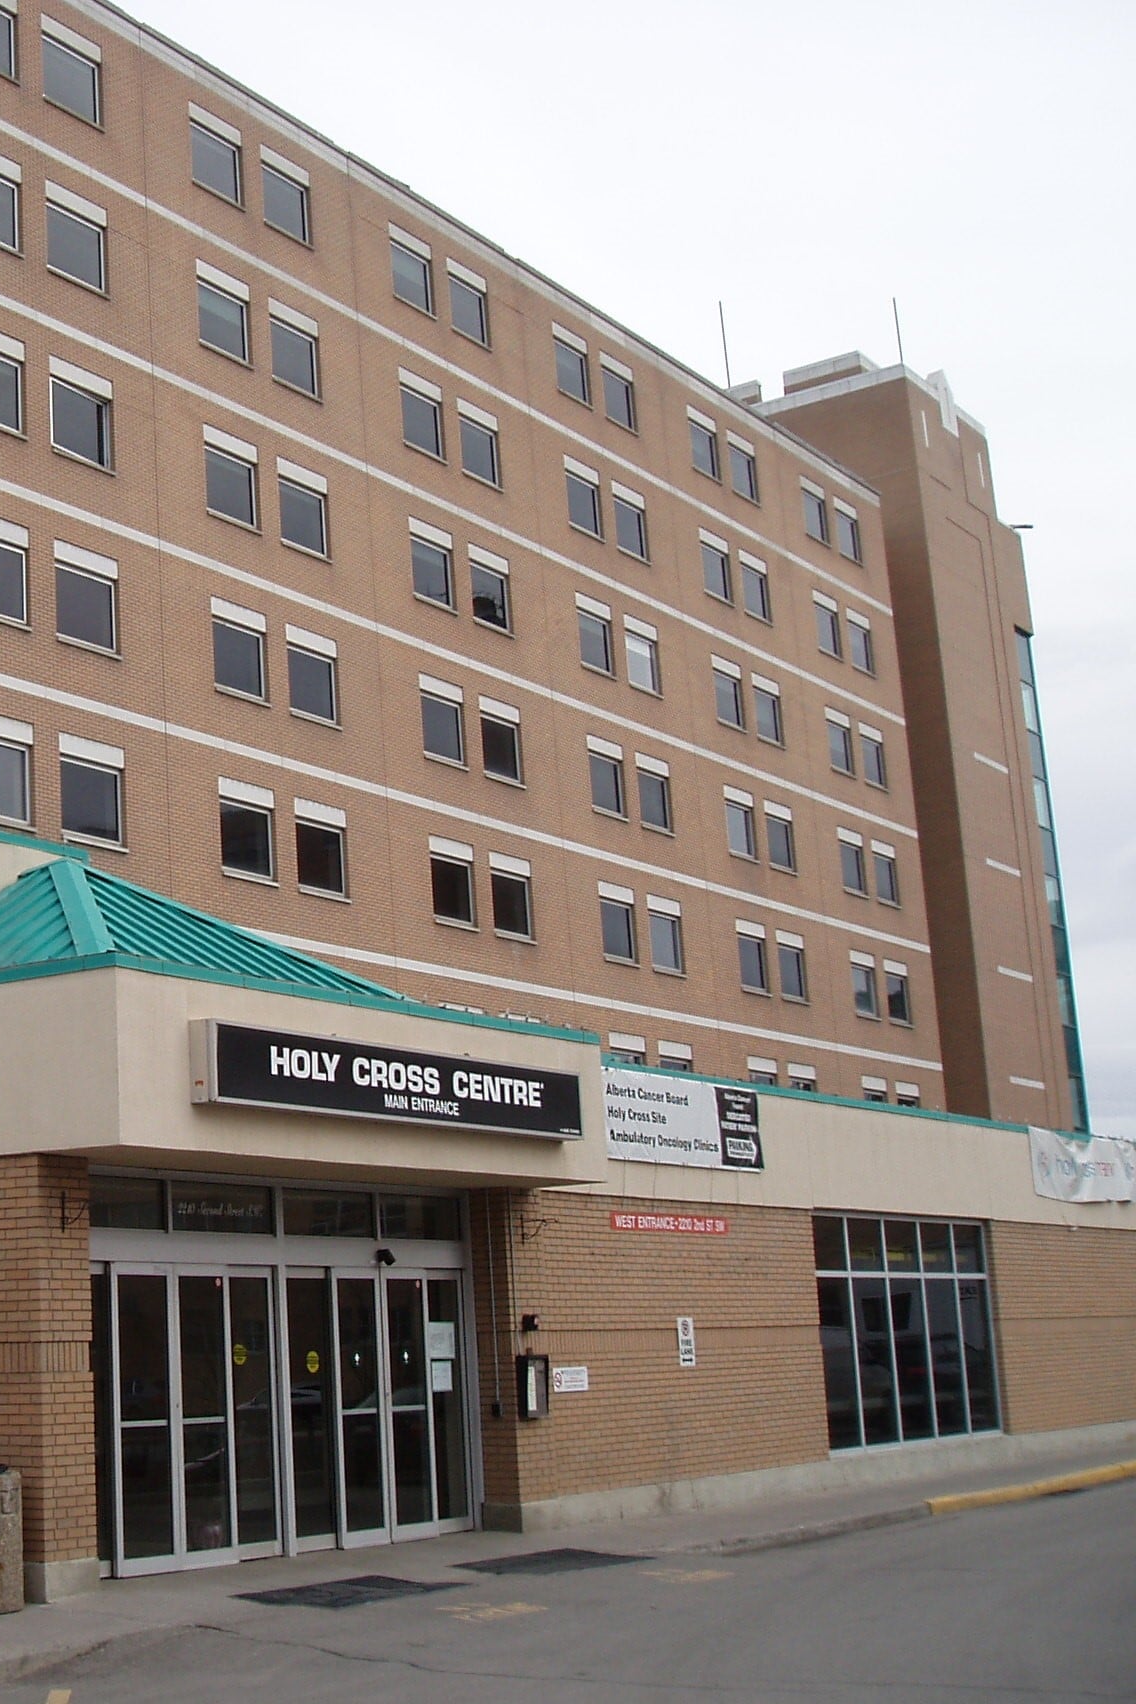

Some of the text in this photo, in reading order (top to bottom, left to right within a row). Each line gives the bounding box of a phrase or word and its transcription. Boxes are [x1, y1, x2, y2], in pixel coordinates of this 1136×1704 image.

[270, 1045, 543, 1108] HOLY CROSS CENTRE
[384, 1093, 460, 1117] MAIN ENTRANCE
[606, 1083, 689, 1107] Alberta Cancer Board
[607, 1106, 667, 1125] Holy Cross Site
[610, 1129, 720, 1153] Ambulatory Oncology Clinics
[614, 1214, 636, 1228] WEST
[637, 1216, 675, 1230] ENTRANCE
